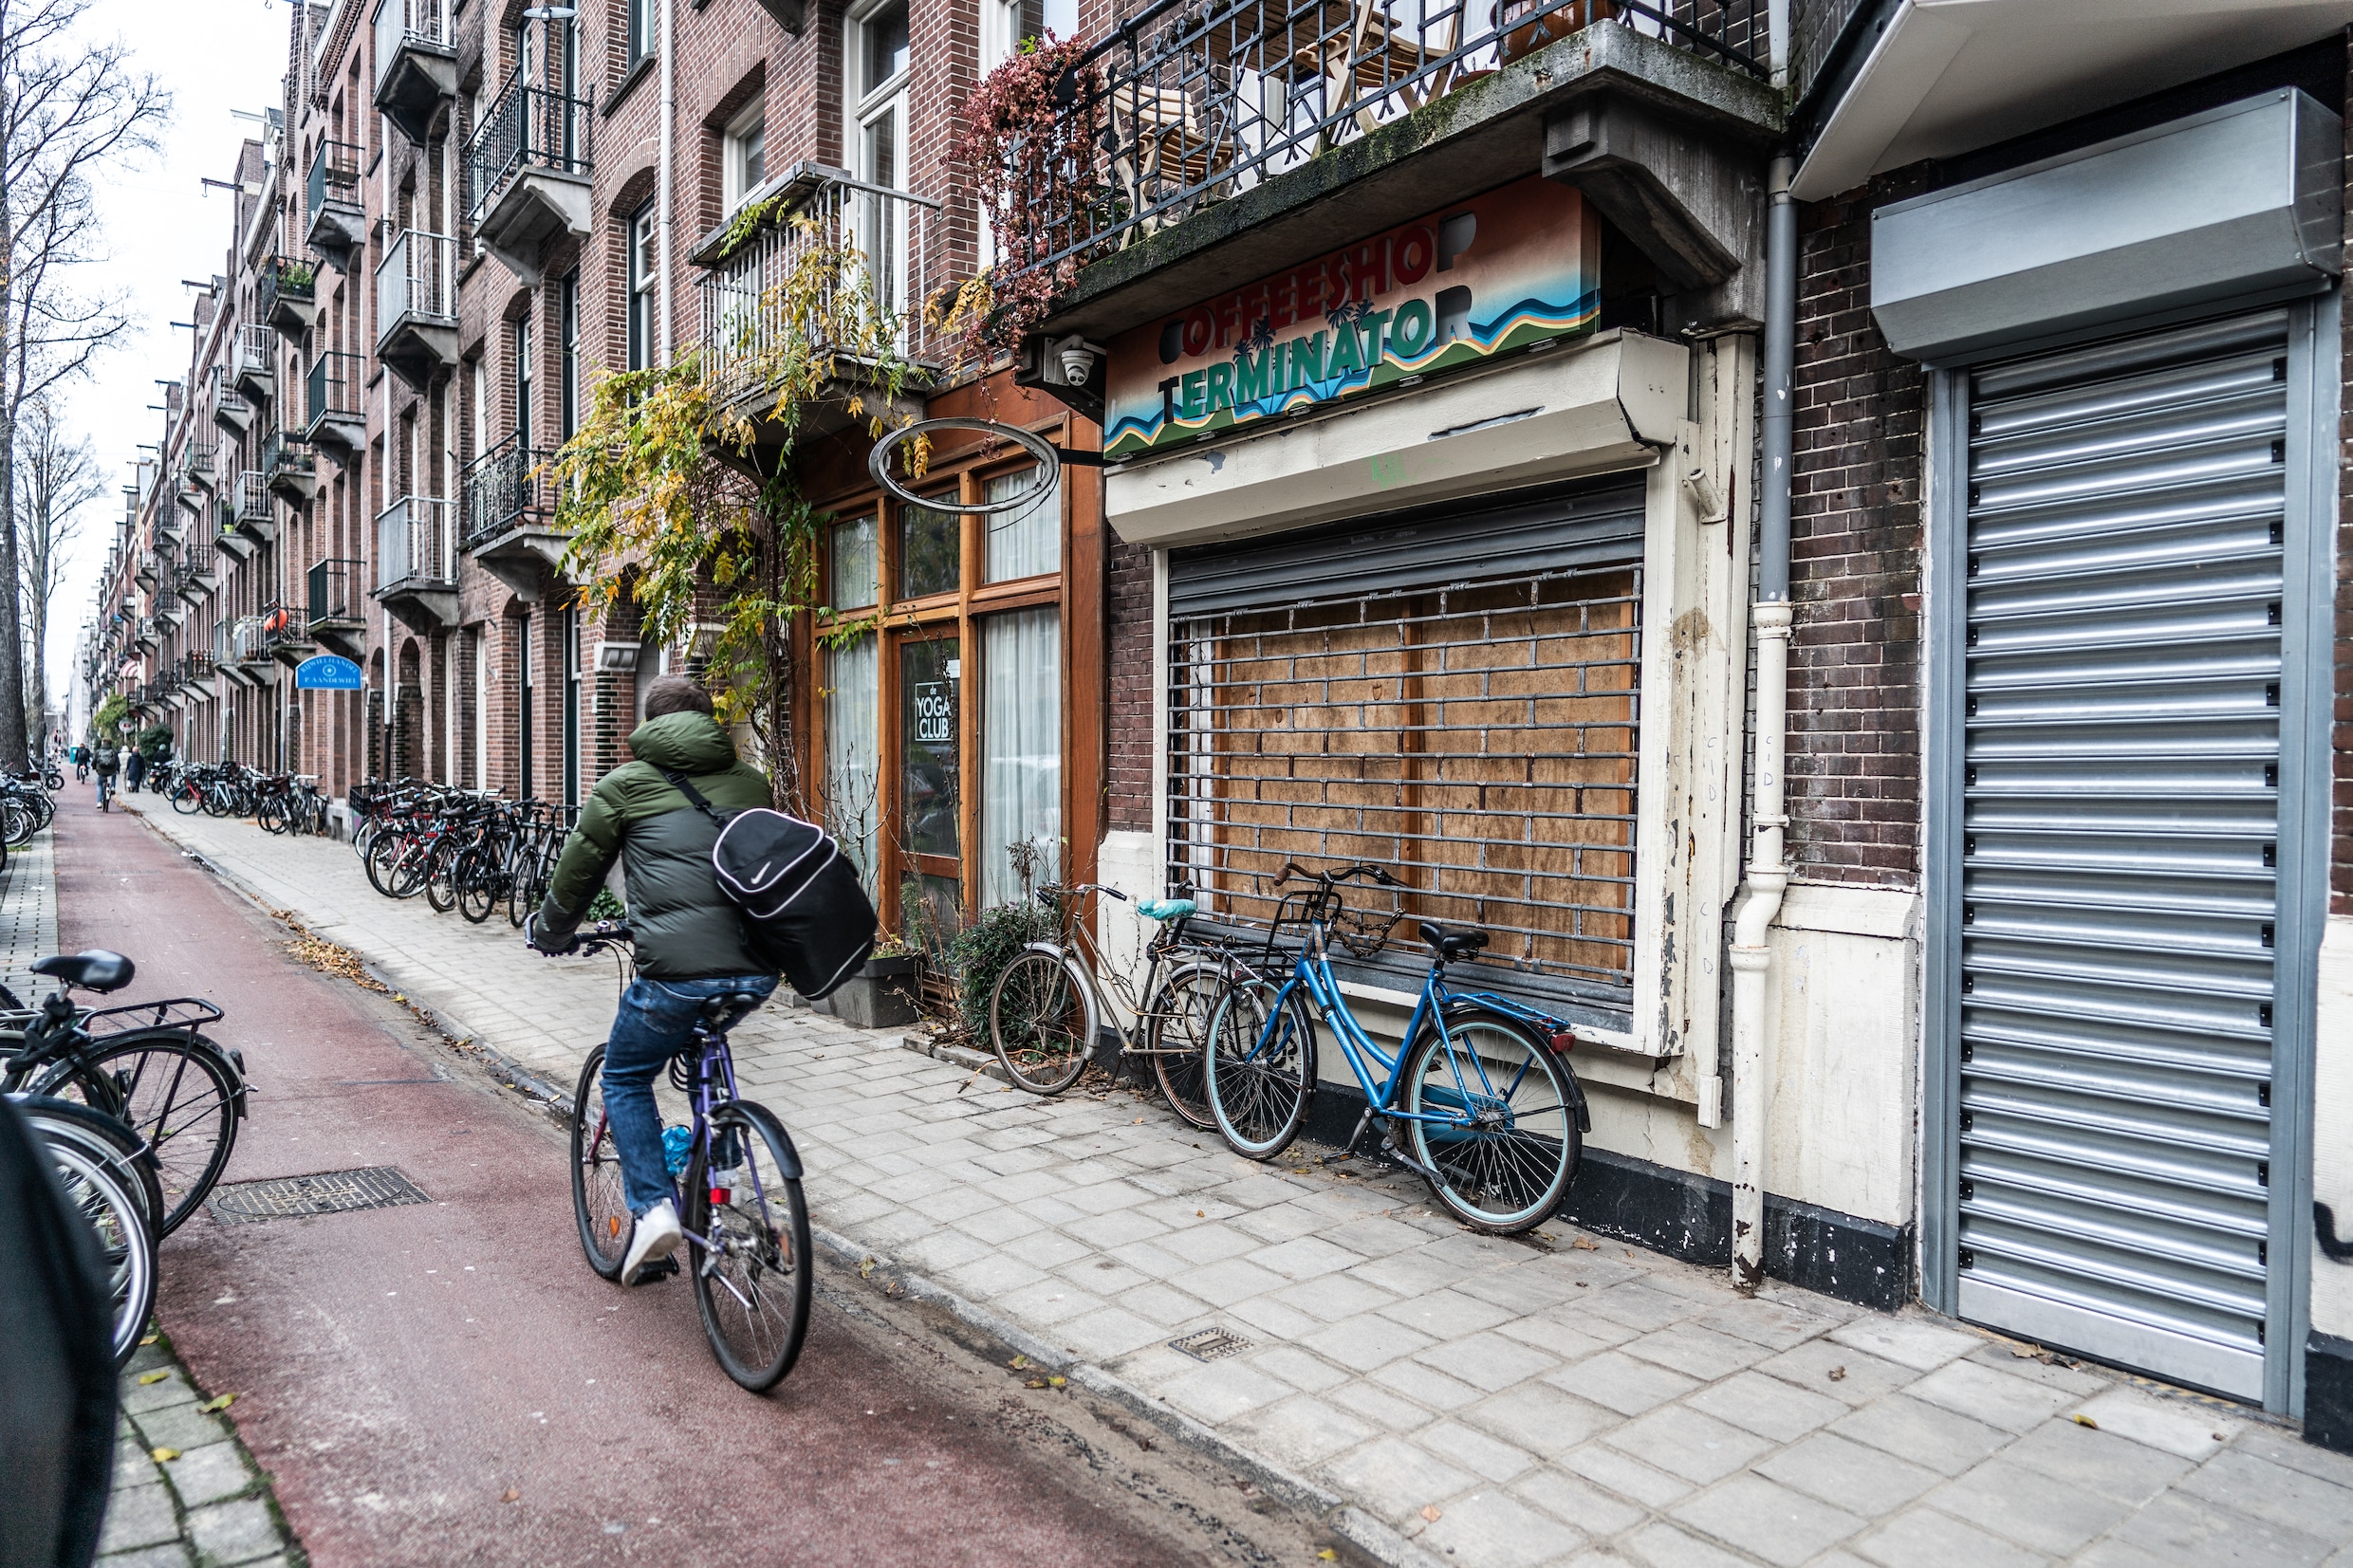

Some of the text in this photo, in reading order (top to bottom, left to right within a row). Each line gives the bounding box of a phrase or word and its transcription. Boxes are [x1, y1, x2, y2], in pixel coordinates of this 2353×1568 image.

[1158, 286, 1473, 425] TERMINATOR
[929, 684, 937, 695] de
[917, 696, 952, 717] YOGA
[919, 718, 949, 738] CLUB
